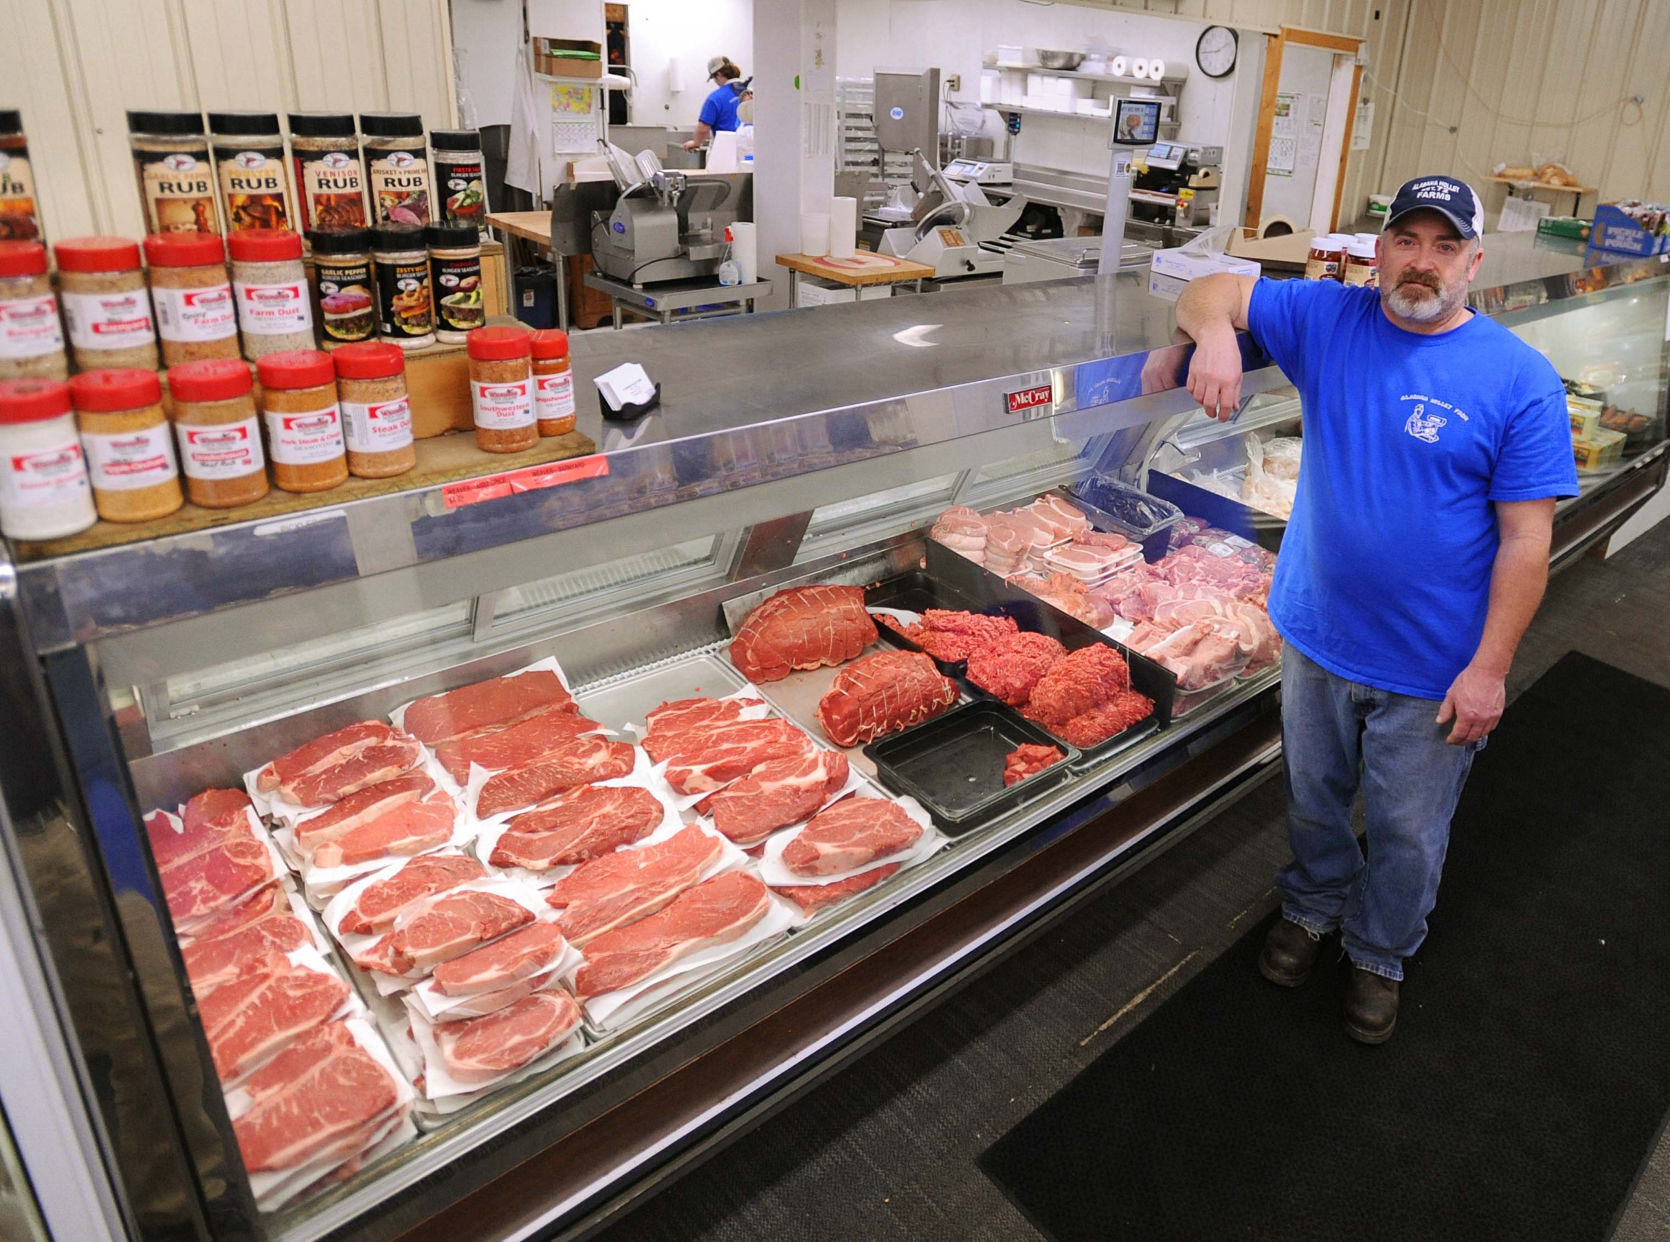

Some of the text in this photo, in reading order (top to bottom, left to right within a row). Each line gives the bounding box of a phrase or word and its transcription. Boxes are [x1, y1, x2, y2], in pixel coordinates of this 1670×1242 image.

[159, 180, 208, 194] RUB
[230, 177, 279, 190] RUB
[317, 176, 359, 190] RUB
[384, 176, 423, 188] RUB
[1416, 191, 1451, 201] FARMS
[344, 267, 367, 275] PEPPER
[249, 307, 300, 316] Farm Dust
[1011, 389, 1050, 409] McCray
[480, 402, 530, 411] Southwestern
[371, 425, 399, 434] Steak
